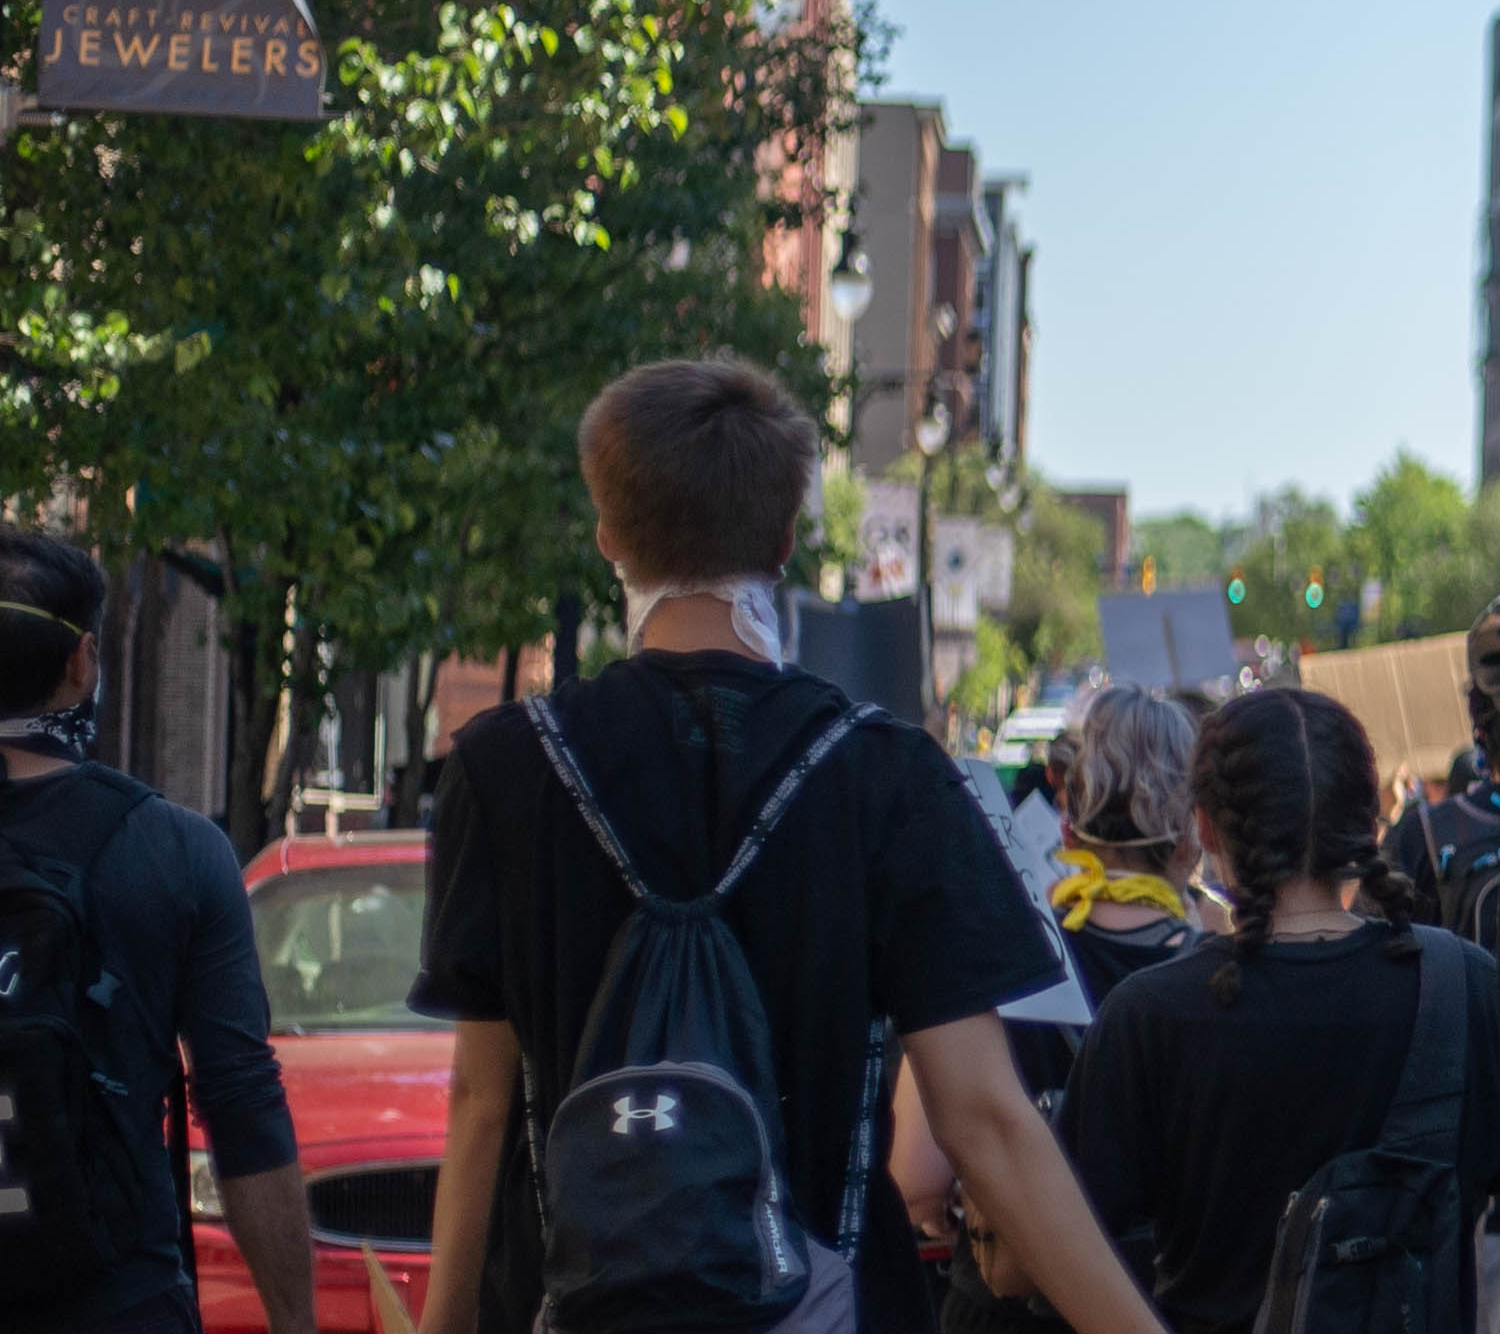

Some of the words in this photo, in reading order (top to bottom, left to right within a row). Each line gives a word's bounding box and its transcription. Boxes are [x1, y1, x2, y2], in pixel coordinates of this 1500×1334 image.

[63, 4, 157, 28] CRAFT
[181, 10, 307, 37] REVIVAL
[44, 27, 320, 78] JEWELERS
